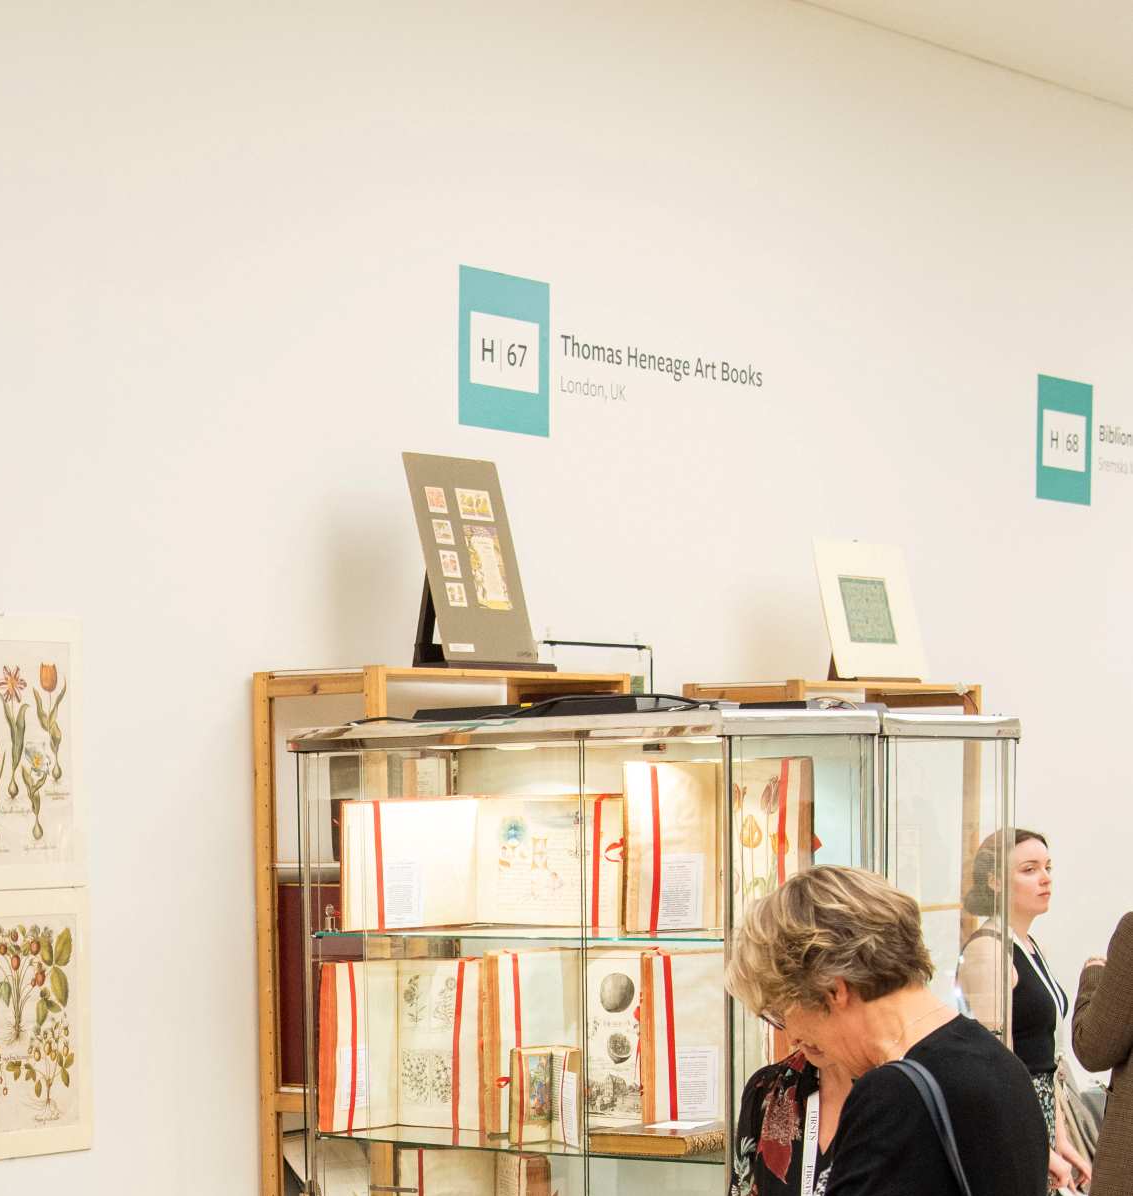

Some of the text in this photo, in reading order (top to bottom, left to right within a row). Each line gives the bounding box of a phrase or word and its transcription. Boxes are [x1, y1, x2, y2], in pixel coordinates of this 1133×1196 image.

[481, 337, 528, 368] H 67
[560, 334, 763, 387] Thomas Heneage Art Books
[560, 375, 626, 401] London, UK
[1050, 429, 1079, 453] H 68
